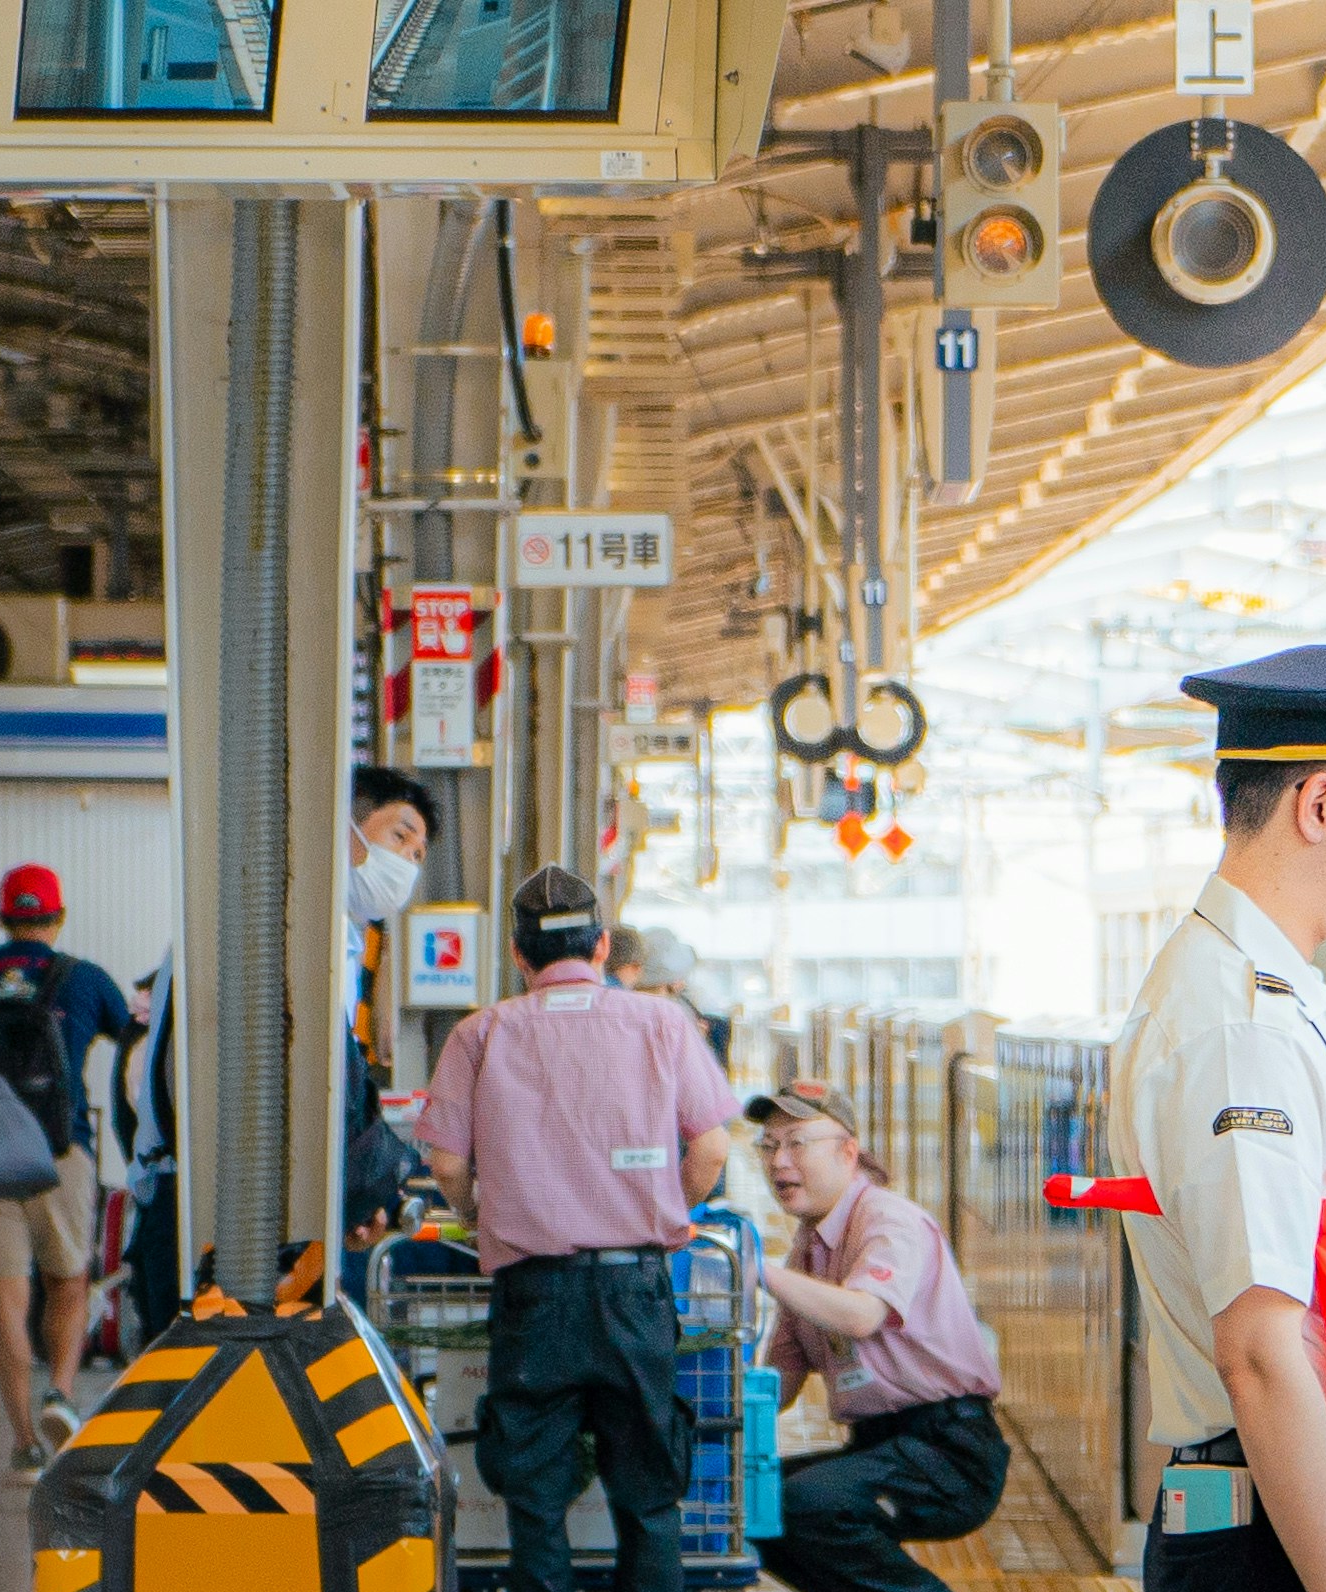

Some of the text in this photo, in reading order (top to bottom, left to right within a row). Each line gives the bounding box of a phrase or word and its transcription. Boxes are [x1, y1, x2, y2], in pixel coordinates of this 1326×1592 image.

[1183, 8, 1245, 85] 上
[939, 329, 974, 369] 11
[556, 532, 661, 570] 11号車
[415, 601, 469, 617] STOP
